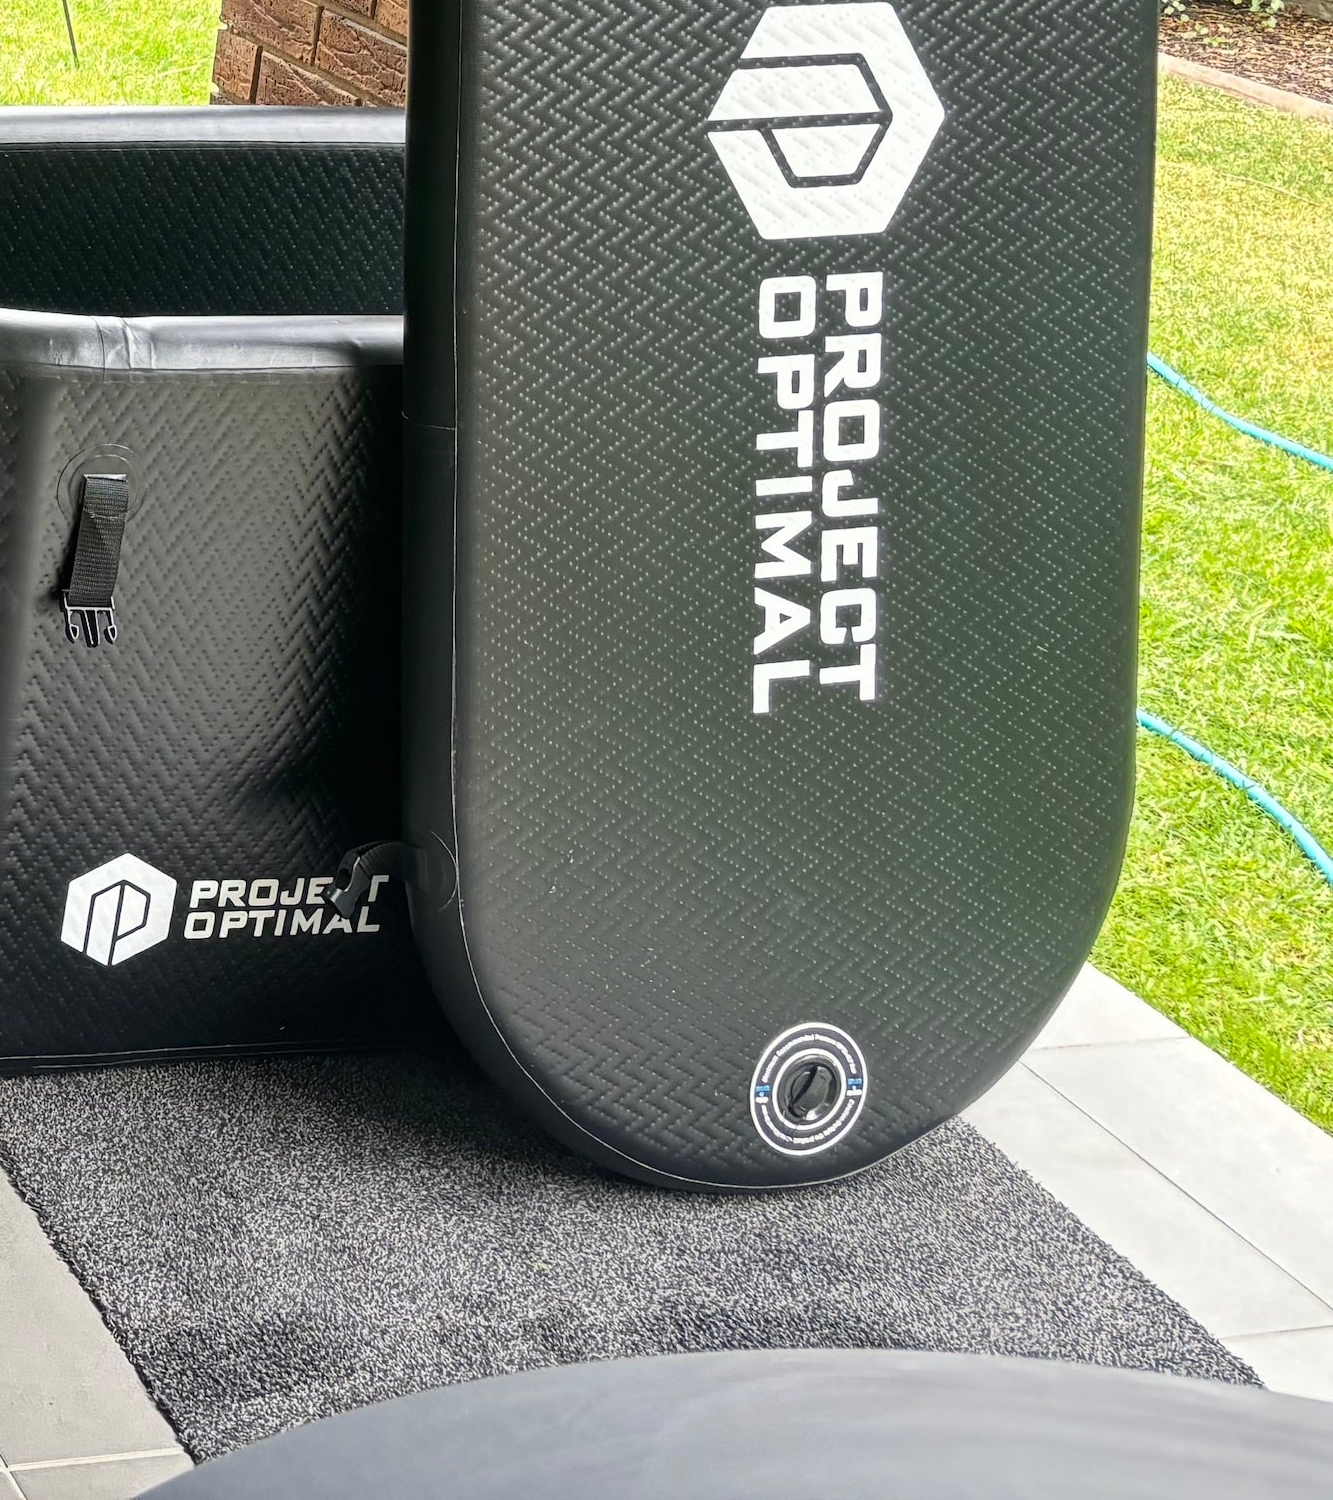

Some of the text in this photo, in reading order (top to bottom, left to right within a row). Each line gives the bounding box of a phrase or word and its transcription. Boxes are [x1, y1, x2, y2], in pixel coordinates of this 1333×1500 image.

[752, 275, 817, 714] OPTIMAL
[820, 272, 884, 701] PROJECT
[183, 906, 381, 940] OPTIMAL
[188, 874, 390, 909] PROJET
